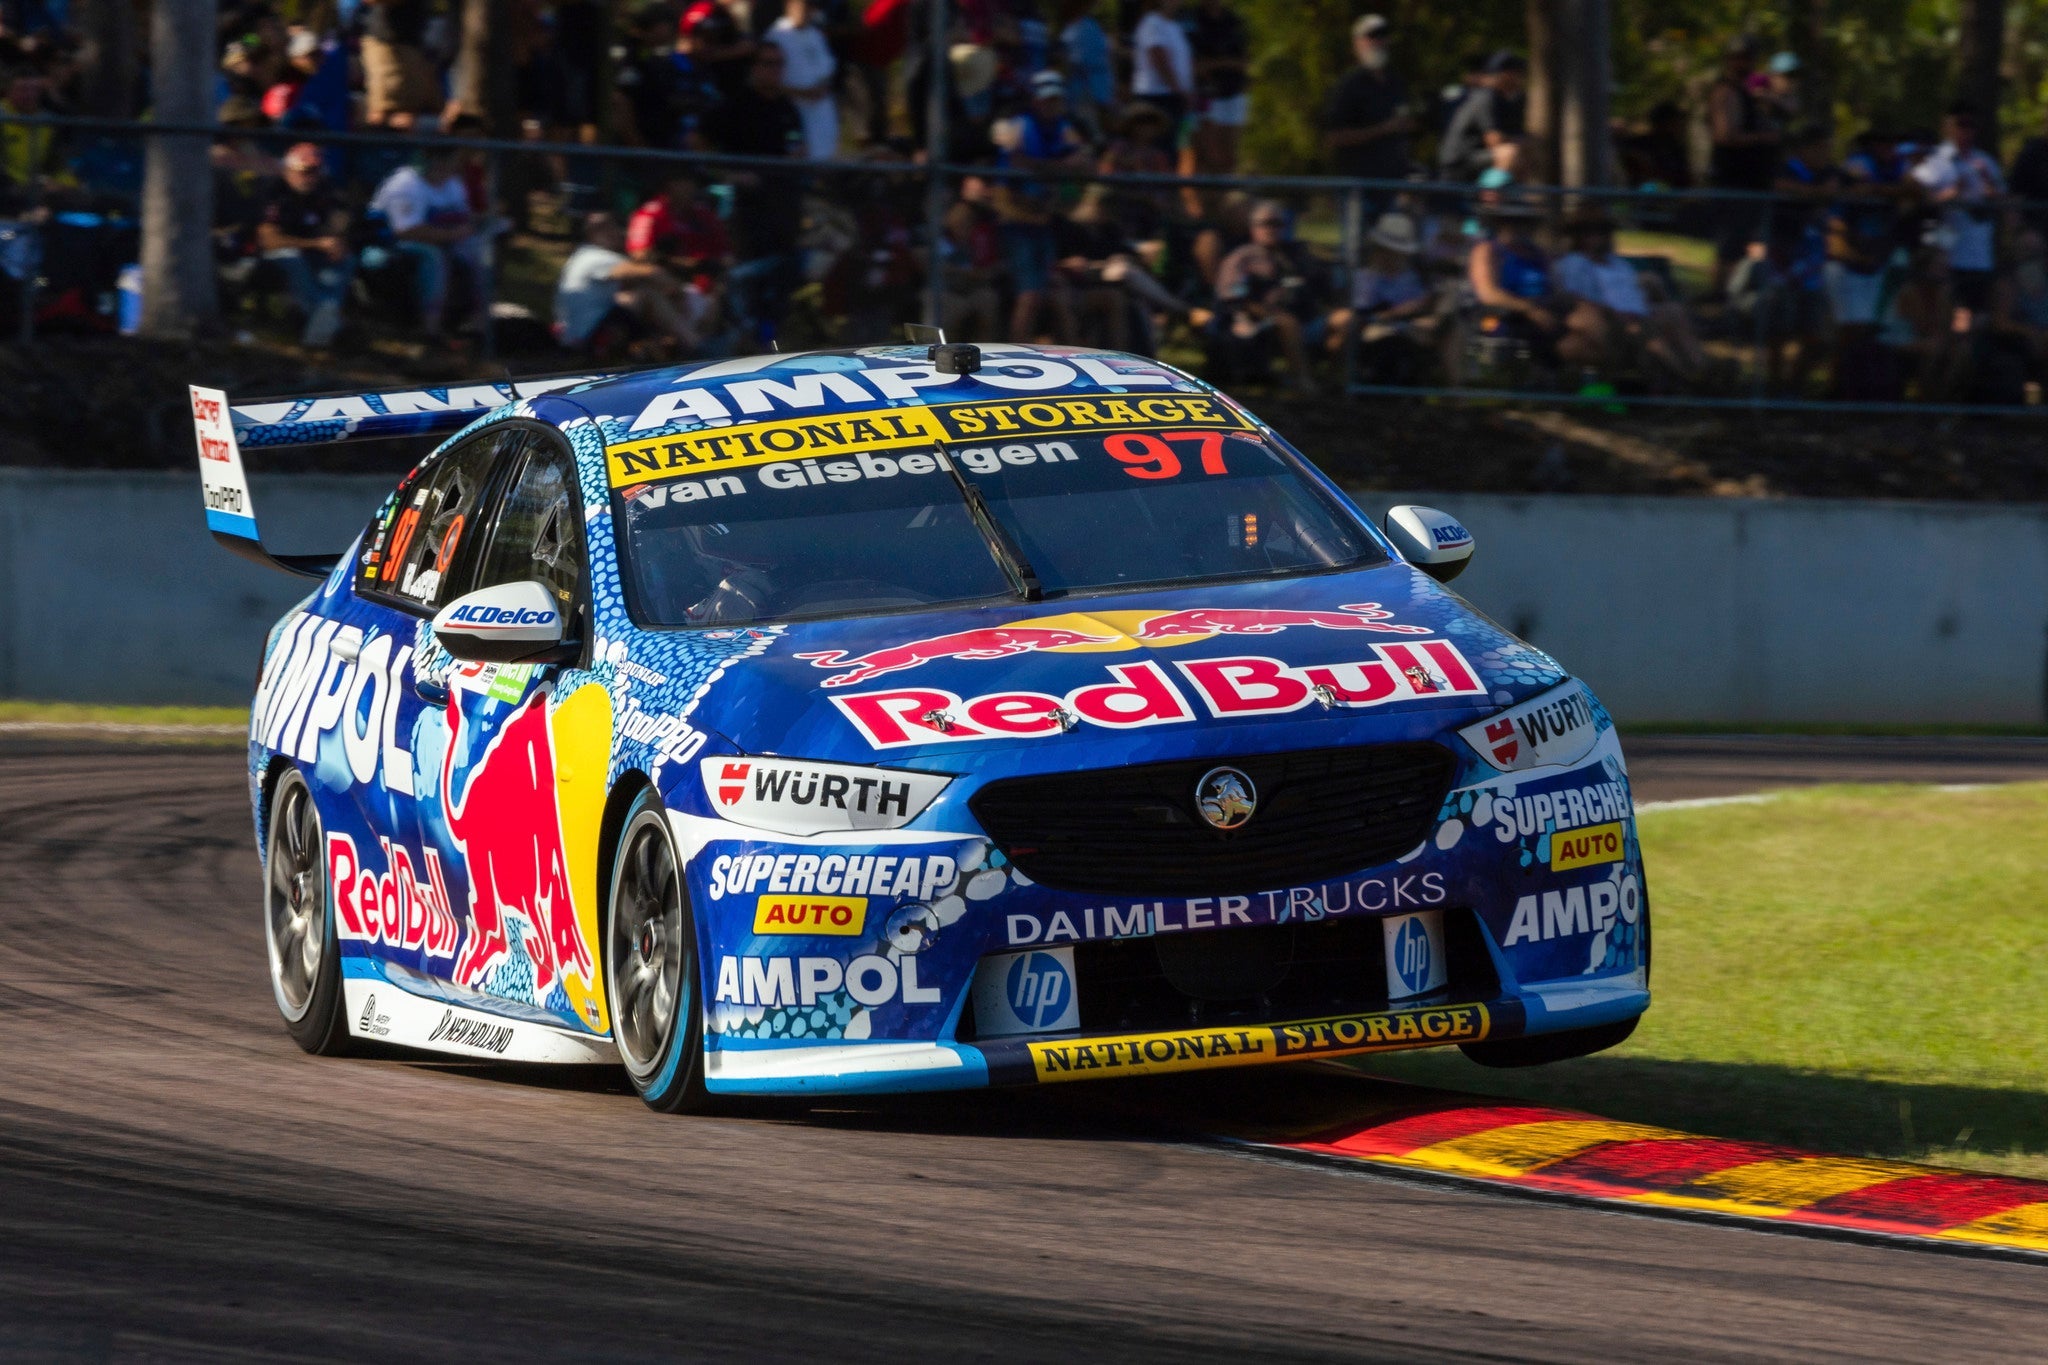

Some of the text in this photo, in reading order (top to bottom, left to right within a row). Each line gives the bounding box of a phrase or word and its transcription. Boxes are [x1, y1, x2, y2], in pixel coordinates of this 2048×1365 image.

[628, 358, 1173, 432] AMPOL
[614, 399, 1226, 477] NATIONAL STORAGE
[1103, 432, 1229, 479] 97
[636, 441, 1079, 509] van Gisbergen
[450, 605, 555, 624] ACDelco
[251, 611, 415, 796] AMPOL
[625, 661, 668, 687] DUNLOP
[828, 639, 1488, 750] Red Bull
[618, 697, 707, 764] ToolPRO
[755, 768, 910, 817] WÜRTH
[709, 854, 957, 901] SUPERCHEAP
[1559, 832, 1618, 861] AUTO
[764, 904, 853, 926] AUTO
[1006, 872, 1447, 945] DAIMLER TRUCKS
[715, 954, 941, 1006] AMPOL
[1401, 917, 1428, 993] hp
[1015, 956, 1063, 1027] hp
[441, 1016, 514, 1054] NEW HOLLAND
[1041, 1008, 1474, 1073] NATIONAL STORAGE
